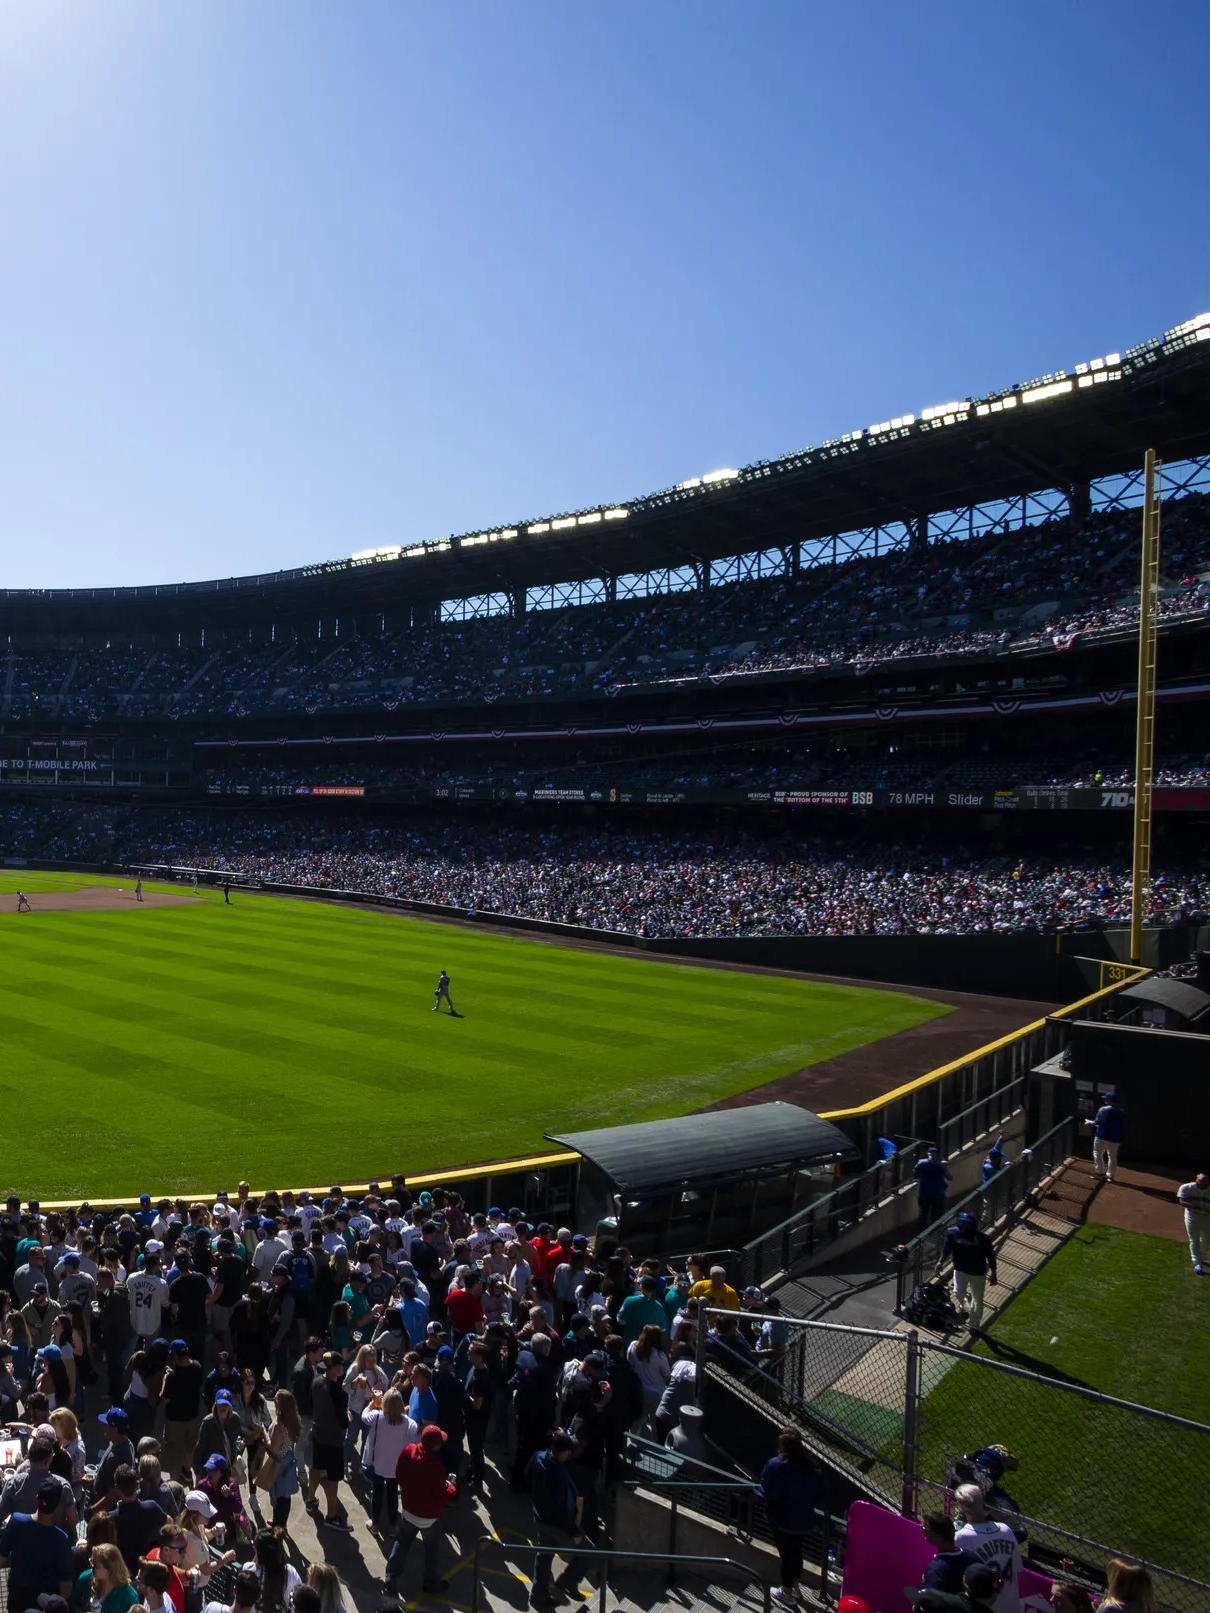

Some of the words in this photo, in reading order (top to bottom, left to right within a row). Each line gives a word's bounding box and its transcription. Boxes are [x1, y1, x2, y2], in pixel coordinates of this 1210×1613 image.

[11, 760, 24, 768] TO
[27, 760, 71, 769] T-MOBILE
[72, 761, 97, 770] PARK
[435, 789, 449, 797] 3:02
[852, 791, 873, 805] BSB
[888, 793, 902, 804] 78
[904, 793, 934, 804] MPH
[948, 793, 984, 806] Slider
[1100, 792, 1129, 807] 710
[1108, 966, 1126, 980] 331
[134, 1281, 157, 1292] GRIFFEY
[135, 1291, 152, 1309] 24
